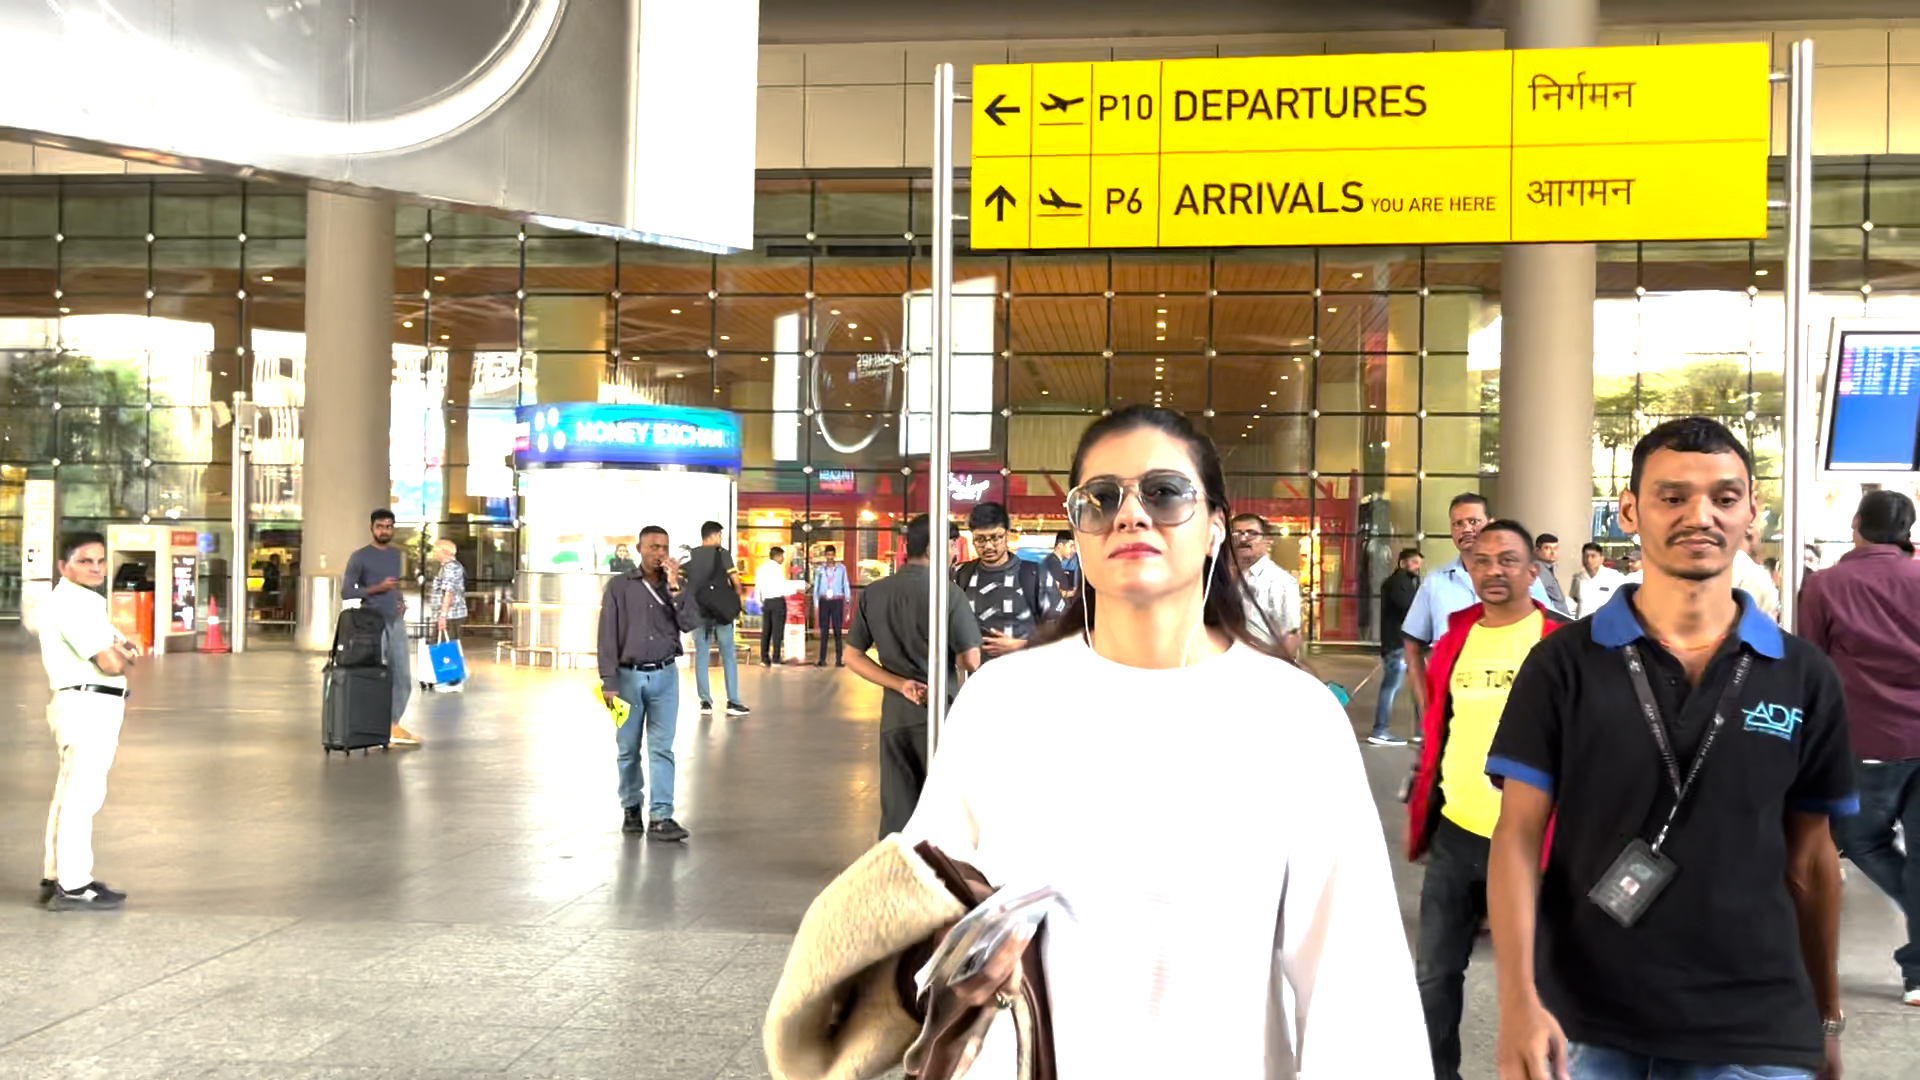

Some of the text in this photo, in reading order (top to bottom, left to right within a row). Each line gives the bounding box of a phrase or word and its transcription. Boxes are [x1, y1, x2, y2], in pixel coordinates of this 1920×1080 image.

[1099, 85, 1427, 122] P10 DEPARTURES
[1528, 71, 1637, 111] निर्गमन
[1106, 181, 1496, 216] P6 ARRIVALS YOU ARE HERE
[1527, 178, 1636, 207] आगमन
[575, 421, 650, 443] MONEY
